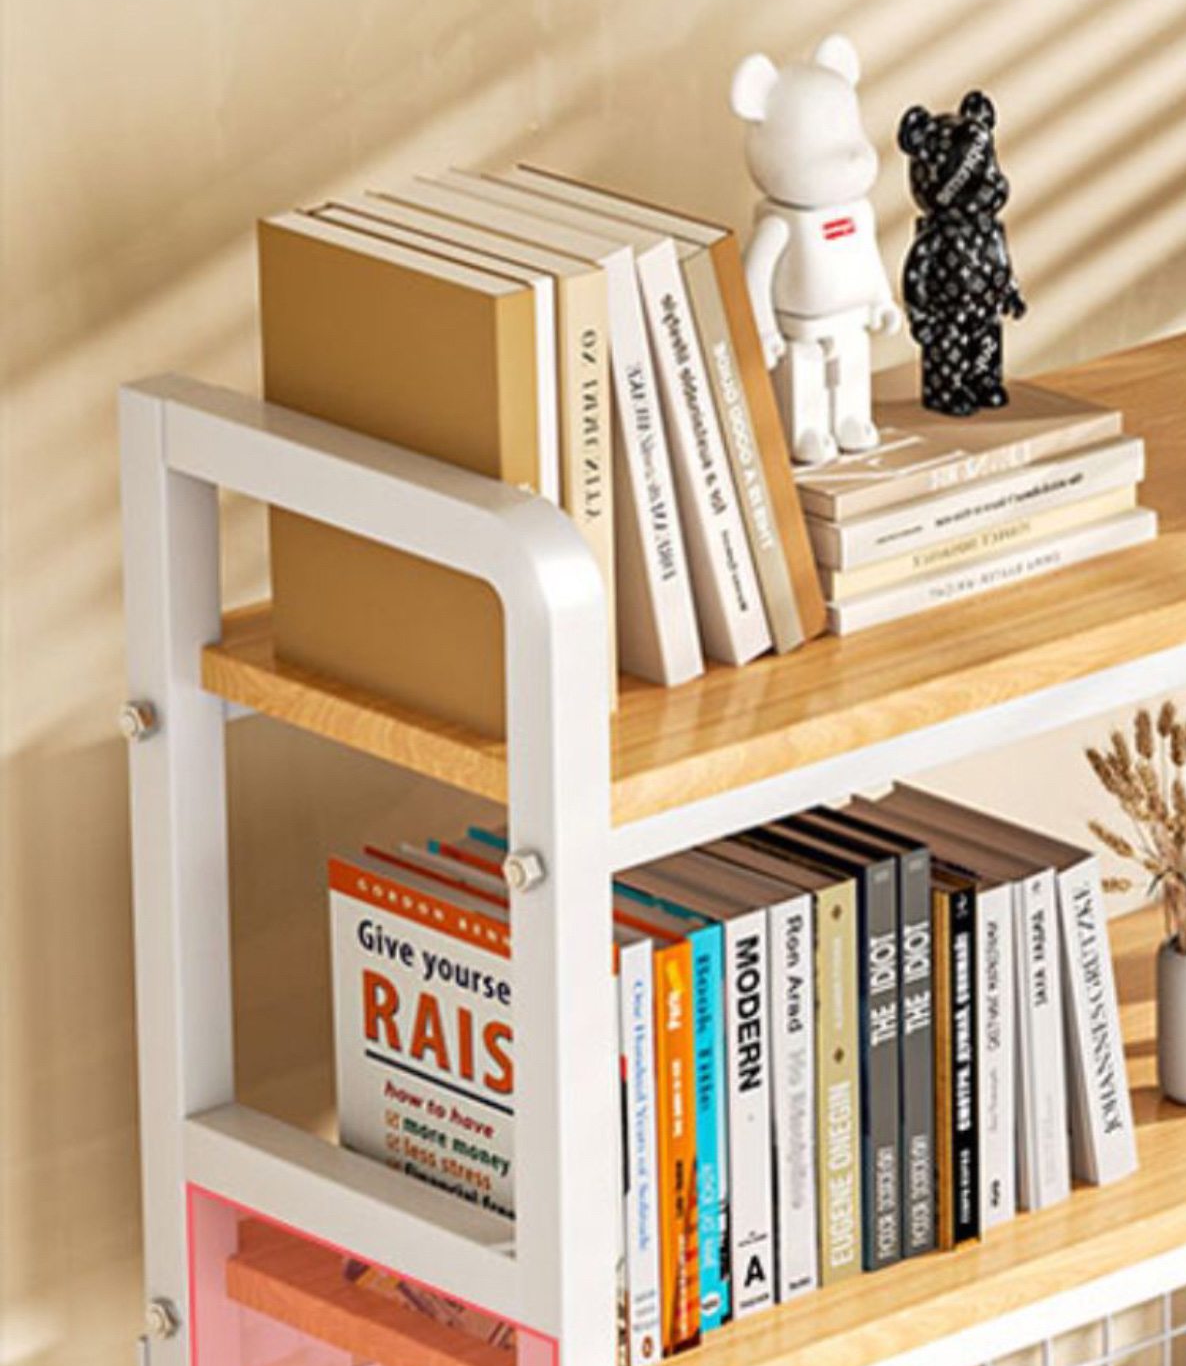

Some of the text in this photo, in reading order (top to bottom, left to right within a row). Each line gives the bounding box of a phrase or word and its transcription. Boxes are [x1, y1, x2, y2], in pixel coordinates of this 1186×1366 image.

[357, 919, 512, 1005] Give yourse
[784, 912, 804, 970] Ron
[904, 915, 931, 1035] THE IDIOT
[734, 933, 762, 1095] MODERN
[785, 970, 806, 1035] Arad
[868, 929, 897, 1047] THE IDIOT
[362, 969, 514, 1094] RAIS
[384, 1080, 494, 1138] how to have
[403, 1118, 510, 1177] more money
[404, 1137, 436, 1167] less
[827, 1078, 855, 1268] EUGENE ONEGIN
